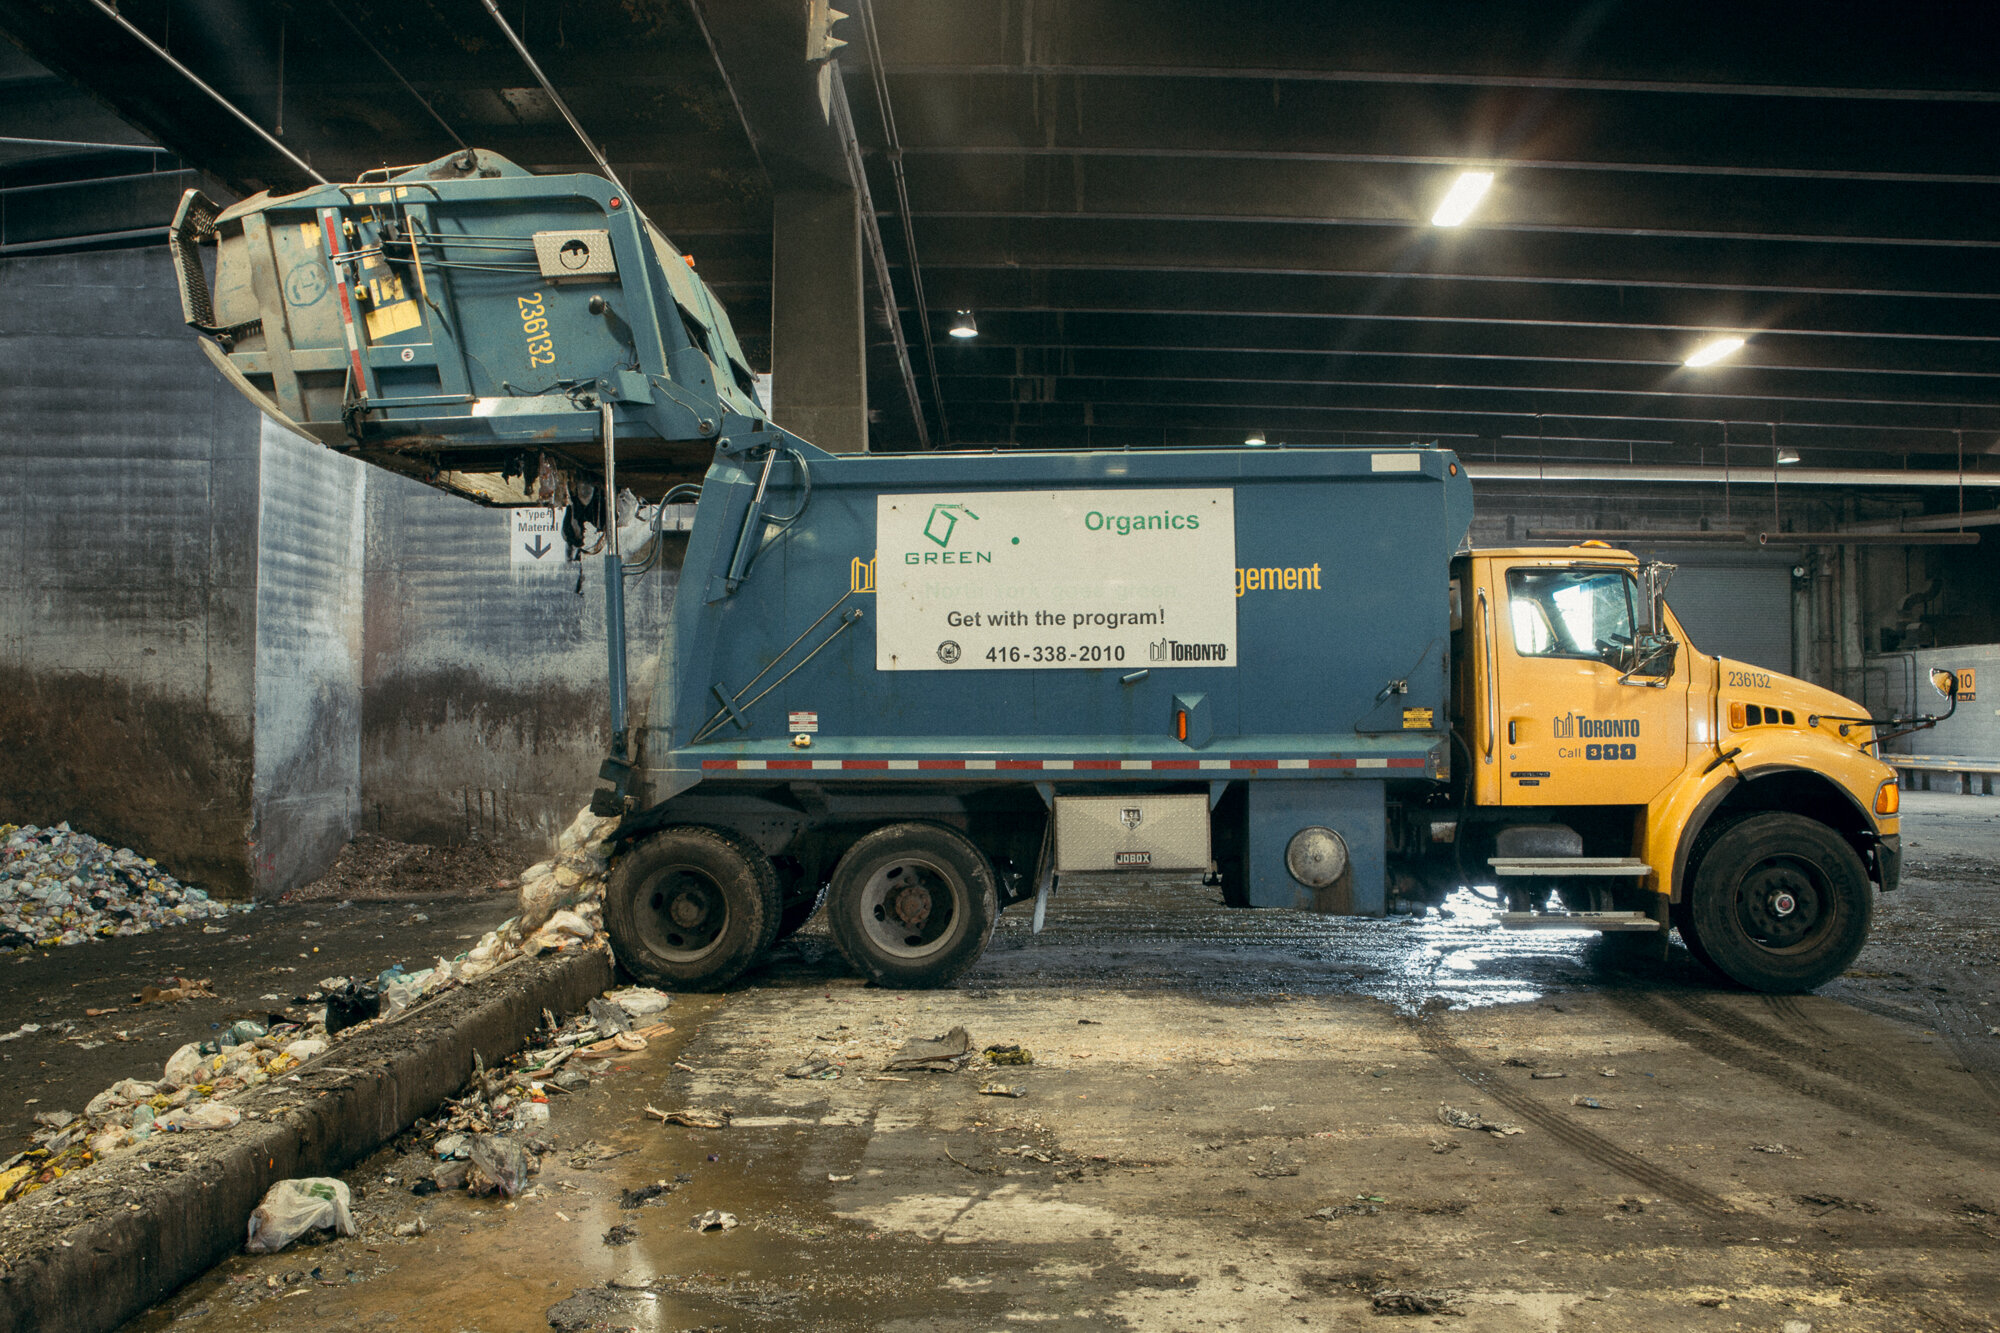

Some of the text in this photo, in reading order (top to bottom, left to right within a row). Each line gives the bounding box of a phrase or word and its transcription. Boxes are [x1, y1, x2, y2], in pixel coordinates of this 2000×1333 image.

[518, 292, 555, 368] 236132
[518, 523, 558, 532] Material
[1084, 511, 1200, 535] Organics
[905, 551, 992, 565] GREEN
[947, 608, 1165, 629] Get with the program!
[985, 645, 1126, 662] 416-338-2010
[1168, 640, 1227, 661] TORONTO
[1728, 671, 1771, 689] 236132
[1960, 674, 1972, 688] 10
[1575, 715, 1640, 738] TORONTO
[1558, 746, 1634, 759] Call 311
[1117, 853, 1150, 864] JOBOX
